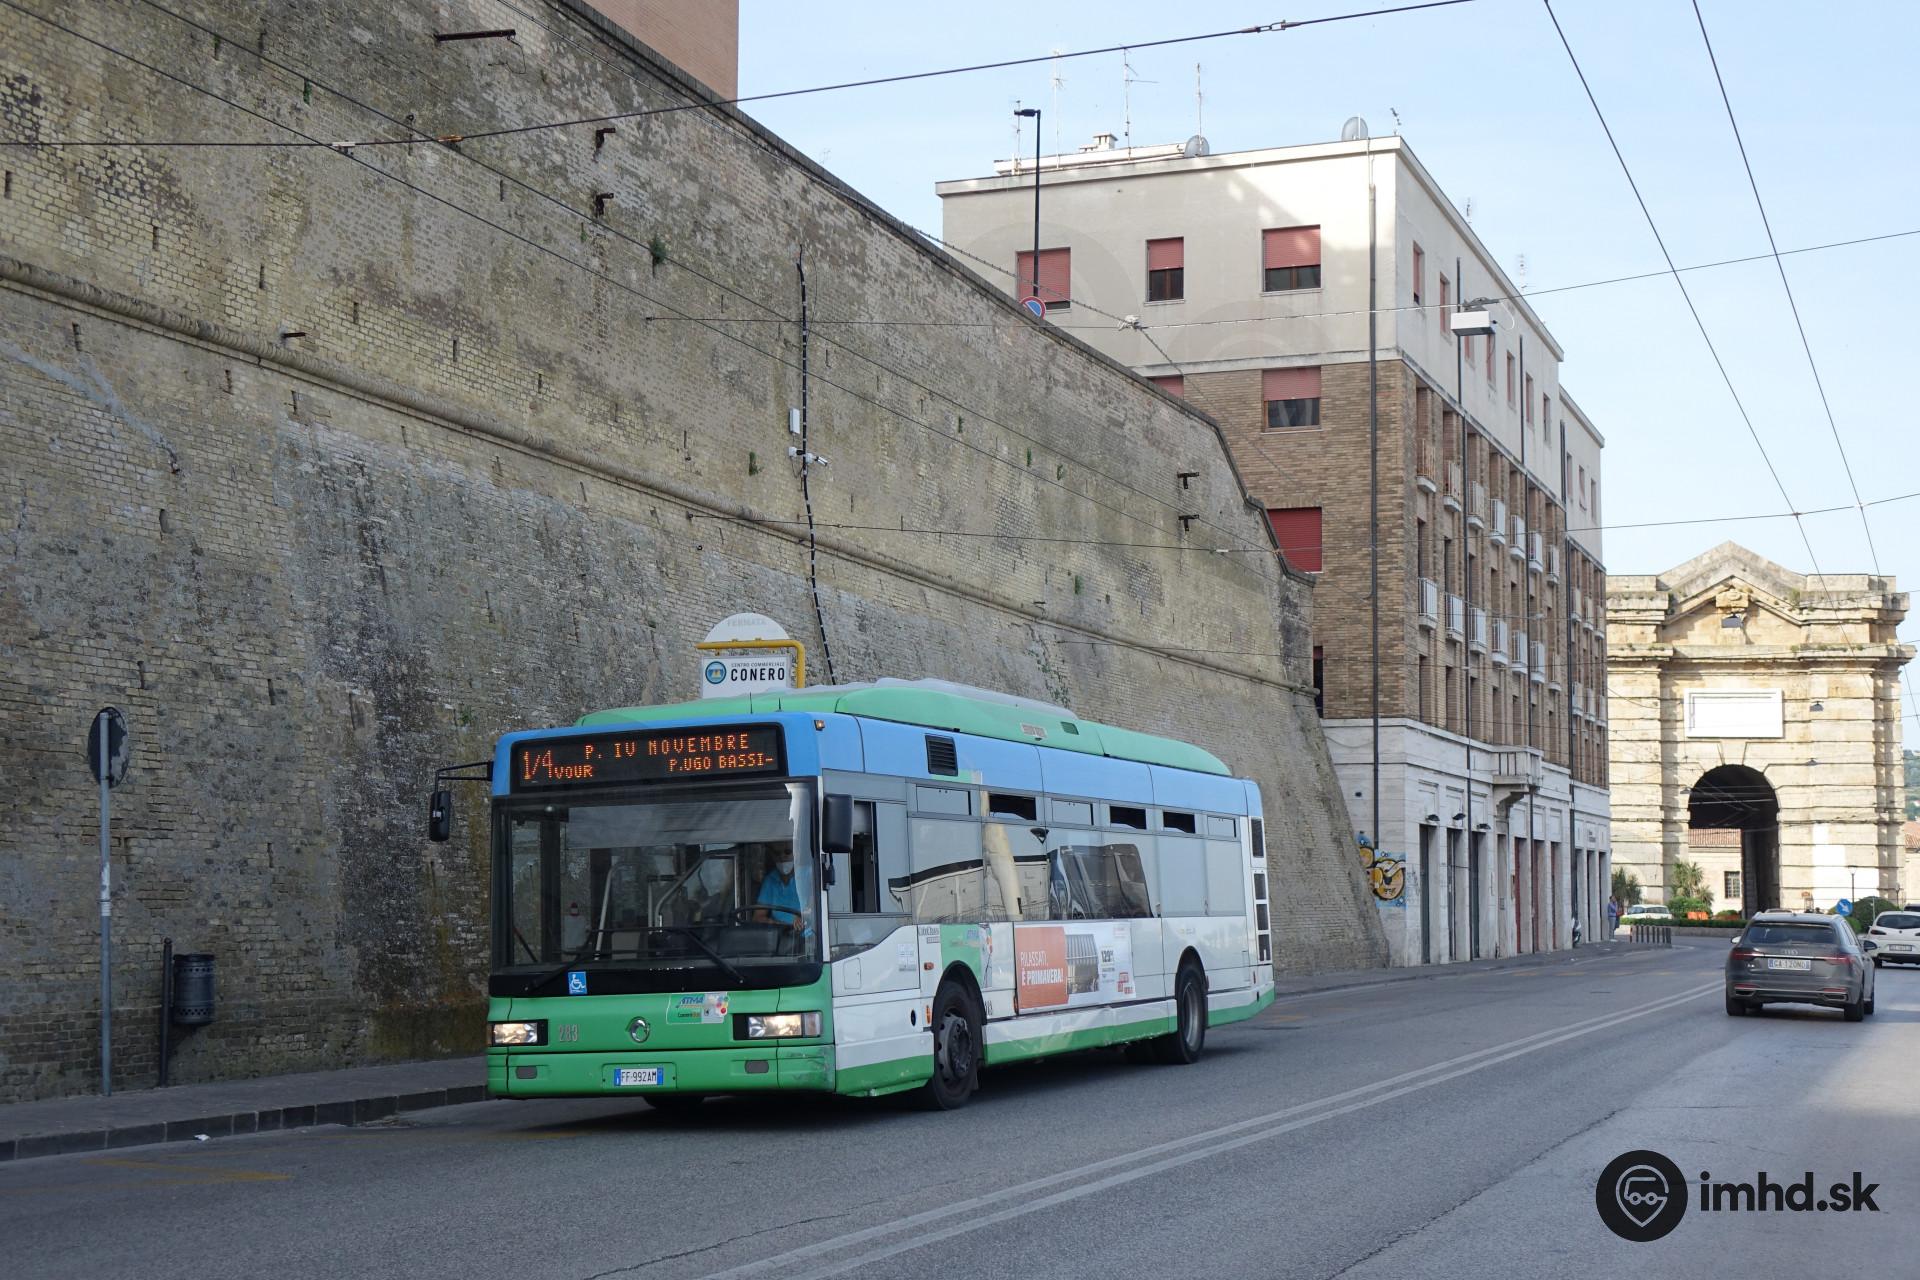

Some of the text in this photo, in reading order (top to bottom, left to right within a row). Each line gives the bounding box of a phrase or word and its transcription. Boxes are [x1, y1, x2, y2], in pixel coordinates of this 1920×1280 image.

[731, 667, 785, 681] CONERO
[585, 744, 602, 760] P.
[648, 733, 749, 755] NOVEMBRE
[523, 750, 552, 779] 1/4
[554, 764, 593, 779] VOUR
[669, 752, 773, 772] P.UGO BASSI-
[1021, 967, 1064, 986] È PRIMAVERA!
[559, 1023, 579, 1042] 283
